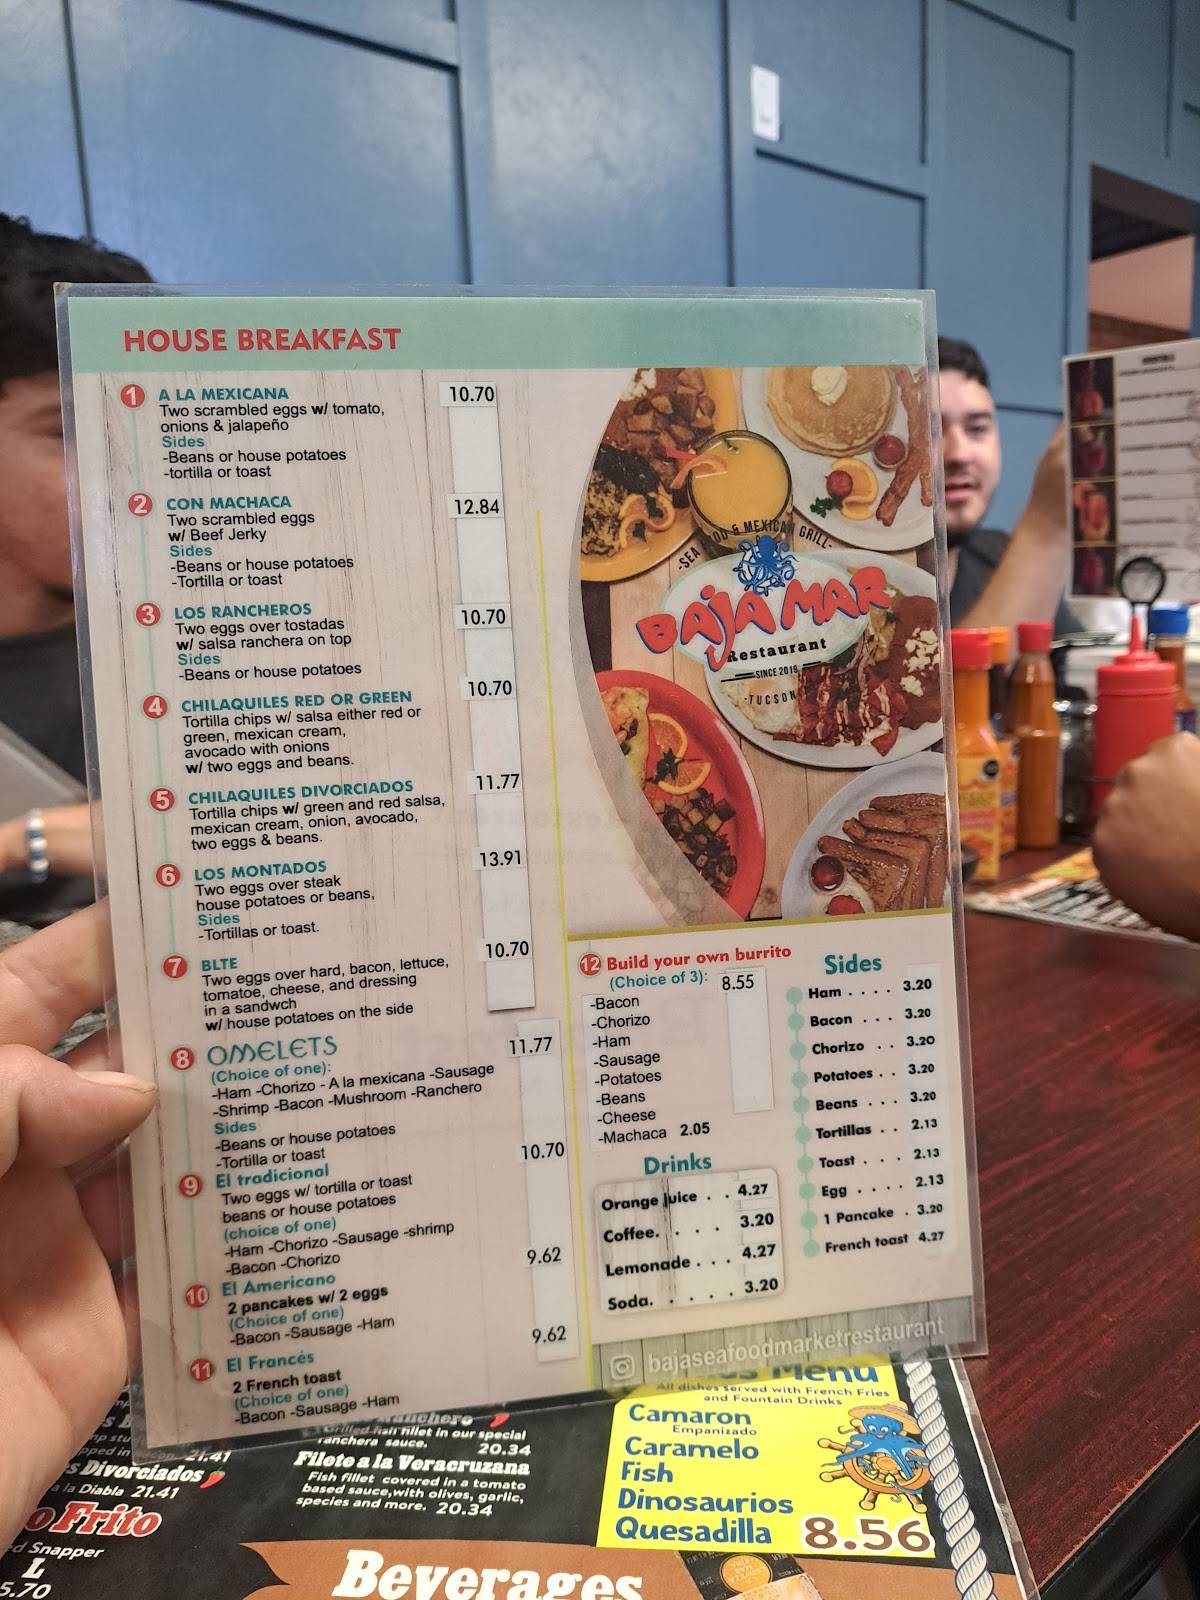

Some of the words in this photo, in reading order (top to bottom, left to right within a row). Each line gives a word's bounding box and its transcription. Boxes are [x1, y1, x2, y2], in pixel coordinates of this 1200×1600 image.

[125, 329, 227, 352] HOUSE
[238, 328, 402, 351] BREAKFAST
[159, 389, 170, 401] A
[176, 389, 196, 401] LA
[202, 388, 289, 401] MEXICANA
[450, 386, 495, 402] 10.70
[159, 404, 190, 417] Two
[194, 403, 268, 417] scrambled
[273, 406, 308, 418] eggs
[311, 402, 329, 415] w/
[332, 403, 385, 416] tomato,
[160, 420, 209, 433] onions
[213, 419, 224, 432] &
[228, 418, 289, 435] jalapeño
[163, 451, 214, 464] -Beans
[219, 453, 234, 463] or
[238, 450, 281, 462] house
[286, 449, 347, 464] potatoes
[167, 498, 204, 511] CON
[210, 496, 292, 509] MACHACA
[455, 499, 500, 515] 12.84
[781, 566, 893, 630] MAR
[175, 607, 206, 620] LOS
[211, 603, 312, 618] RANCHEROS
[461, 608, 506, 625] 10.70
[727, 637, 828, 663] Restaurant
[755, 668, 778, 679] SINCE
[779, 666, 798, 676] 2019
[468, 680, 512, 697] 10.70
[181, 696, 289, 713] CHILAQUILES
[295, 695, 325, 707] RED
[331, 693, 354, 706] OR
[359, 691, 412, 705] GREEN
[476, 773, 520, 790] 11.77
[189, 787, 296, 805] CHILAQUILES
[301, 780, 413, 798] DIVORCIADOS
[191, 822, 251, 836] mexican
[255, 820, 303, 832] cream,
[308, 817, 351, 828] onion,
[355, 810, 418, 825] avocado,
[480, 850, 521, 867] 13.91
[195, 868, 225, 881] LOS
[232, 861, 327, 878] MONTADOS
[486, 941, 529, 959] 10.70
[607, 954, 649, 971] Build
[654, 956, 691, 970] your
[696, 953, 730, 964] own
[735, 946, 792, 961] burrito
[202, 958, 238, 972] BLTE
[825, 953, 882, 975] Sides
[610, 974, 666, 990] (Choice
[671, 971, 686, 984] of
[690, 970, 708, 985] 3):
[722, 974, 754, 991] 8.55
[808, 987, 842, 999] Ham
[903, 978, 932, 992] 3.20
[590, 997, 640, 1010] -Bacon
[591, 1014, 650, 1029] -Chorizo
[810, 1016, 853, 1027] Bacon
[905, 1008, 931, 1019] 3.20
[207, 1036, 338, 1066] OMELETS
[509, 1036, 553, 1055] 11.77
[592, 1035, 631, 1048] -Ham
[812, 1041, 864, 1055] Chorizo
[907, 1035, 936, 1047] 3.20
[594, 1053, 661, 1068] -Sausage
[595, 1072, 662, 1086] -Potatoes
[814, 1070, 873, 1083] Potatoes
[908, 1063, 935, 1075] 3.20
[596, 1093, 646, 1106] -Beans
[816, 1099, 858, 1111] Beans
[910, 1091, 936, 1103] 3.20
[597, 1110, 656, 1125] -Cheese
[598, 1129, 667, 1144] -Machaca
[680, 1122, 710, 1137] 2.05
[815, 1124, 872, 1139] Tortillas
[911, 1118, 938, 1130] 2.13
[521, 1142, 565, 1160] 10.70
[819, 1156, 855, 1168] Toast
[914, 1148, 940, 1160] 2.13
[644, 1153, 712, 1175] Drinks
[217, 1174, 231, 1188] El
[237, 1164, 329, 1186] tradicional
[821, 1185, 847, 1199] Egg
[915, 1174, 944, 1188] 2.13
[601, 1197, 659, 1211] Orange
[663, 1191, 698, 1209] juice
[738, 1184, 768, 1196] 4.27
[740, 1213, 774, 1228] 3.20
[824, 1214, 830, 1225] 1
[836, 1207, 894, 1223] Pancake
[917, 1203, 943, 1216] 3.20
[225, 1245, 264, 1258] -Ham
[268, 1237, 328, 1253] -Chorizo
[332, 1230, 399, 1246] -Sausage
[403, 1223, 454, 1237] -shrimp
[825, 1237, 871, 1253] French
[875, 1234, 908, 1247] toast
[918, 1231, 944, 1242] 4.27
[527, 1246, 561, 1265] 9.62
[606, 1255, 691, 1277] Lemonade
[742, 1243, 776, 1259] 4.27
[223, 1282, 236, 1296] El
[243, 1275, 336, 1294] Americano
[745, 1278, 778, 1294] 3.20
[532, 1326, 566, 1344] 9.62
[648, 1316, 945, 1375] bajaseafoodmarketrestaurant
[227, 1358, 241, 1372] El
[249, 1353, 314, 1370] Francés
[703, 1394, 729, 1402] and
[733, 1395, 794, 1405] Fountain
[798, 1396, 843, 1406] Drinks
[723, 1384, 768, 1393] served
[772, 1386, 801, 1395] with
[806, 1387, 853, 1397] French
[856, 1388, 890, 1398] Fries
[628, 1403, 752, 1426] Camaron
[672, 1424, 758, 1437] Empanizado
[477, 1443, 532, 1456] 20.34
[625, 1436, 759, 1460] Caramelo
[80, 1460, 205, 1483] Divorciados
[293, 1451, 355, 1469] Filete
[356, 1456, 370, 1468] a
[371, 1453, 393, 1469] la
[399, 1455, 530, 1476] Veracruzana
[621, 1461, 674, 1483] Fish
[78, 1483, 125, 1497] Diabla
[130, 1485, 180, 1499] 21.41
[307, 1471, 337, 1482] Fish
[341, 1472, 375, 1484] fillet
[382, 1475, 440, 1487] covered
[443, 1476, 457, 1487] in
[460, 1480, 469, 1488] a
[473, 1478, 527, 1491] tomato
[295, 1496, 350, 1508] species
[352, 1498, 382, 1509] and
[384, 1501, 427, 1511] more.
[435, 1502, 493, 1517] 20.34
[617, 1488, 794, 1515] Dinosaurios
[48, 1501, 163, 1537] Frito
[615, 1516, 772, 1544] Quesadilla
[804, 1516, 931, 1552] 8.56
[28, 1542, 105, 1560] Snapper
[331, 1549, 643, 1600] Beverages
